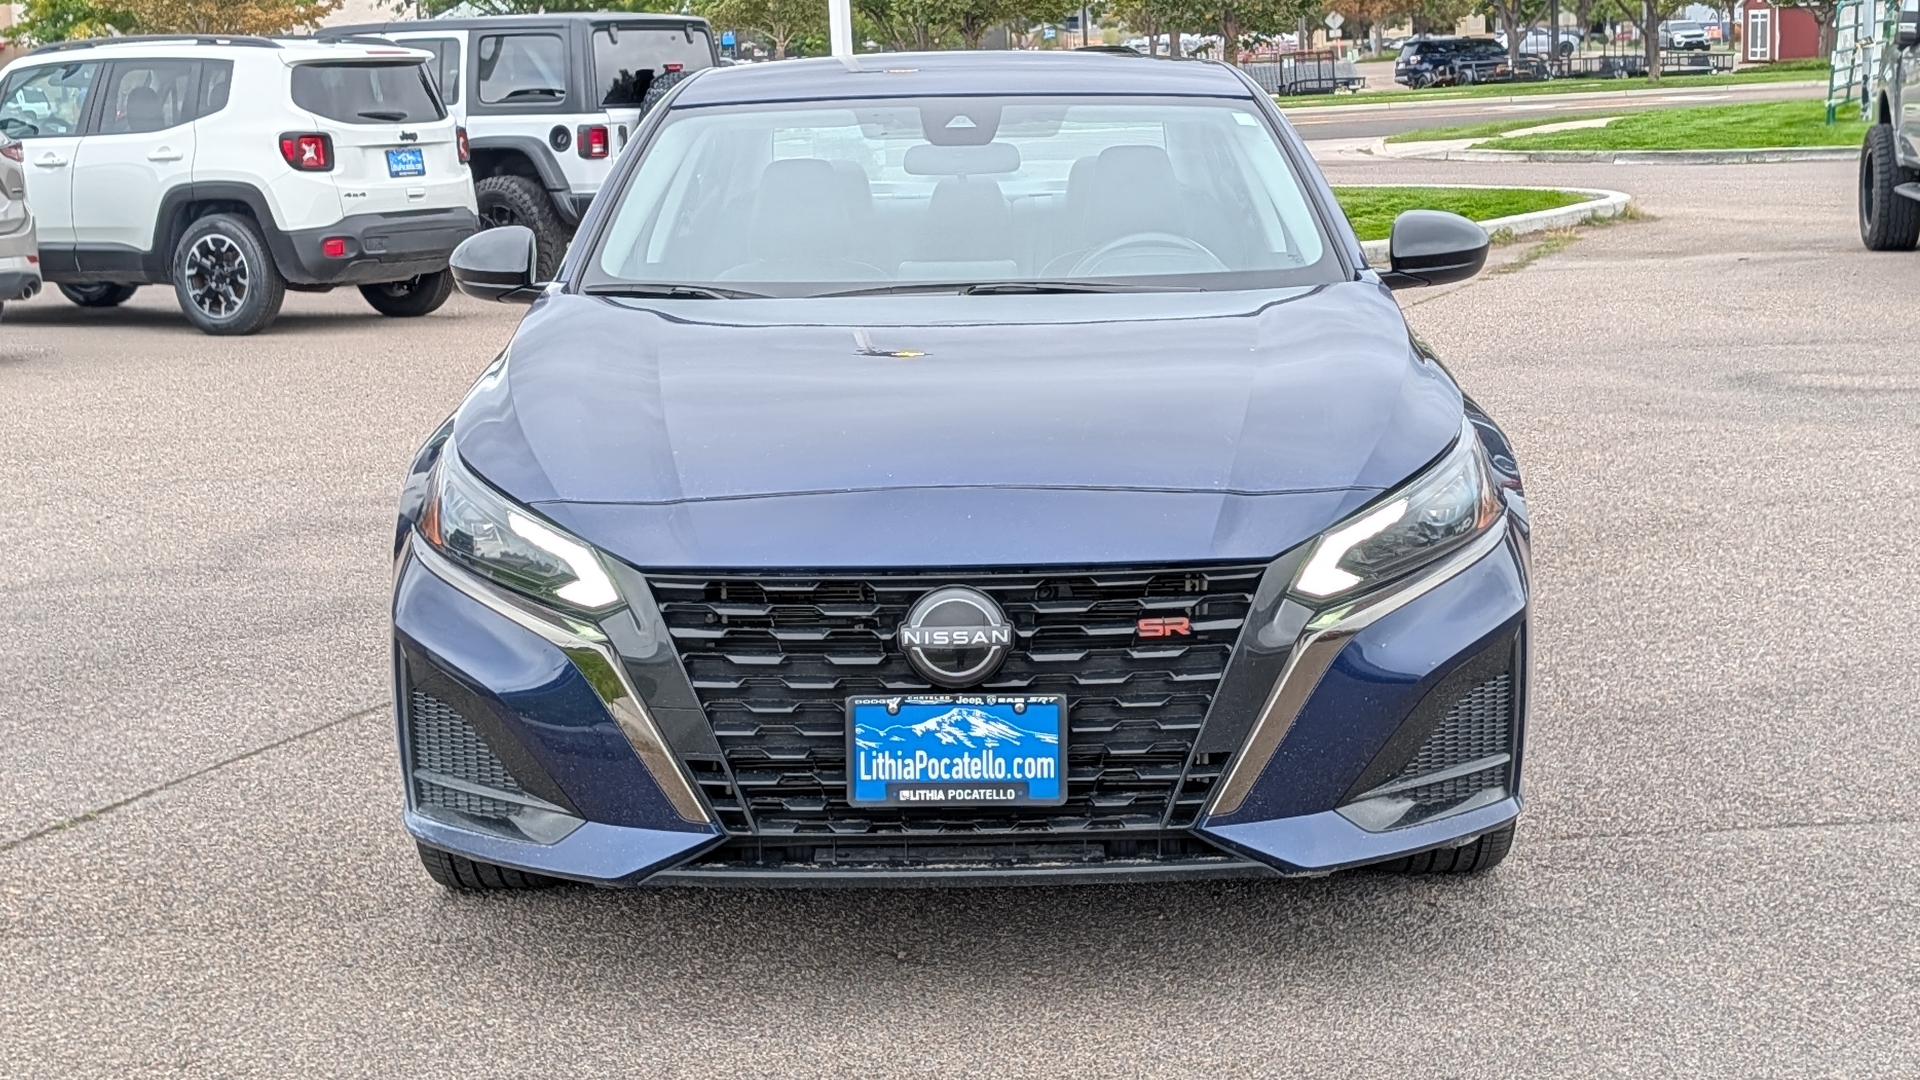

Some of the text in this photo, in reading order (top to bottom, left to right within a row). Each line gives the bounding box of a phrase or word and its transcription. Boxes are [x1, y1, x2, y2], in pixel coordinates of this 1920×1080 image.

[399, 131, 418, 142] Jeep
[1138, 617, 1190, 637] SR
[903, 629, 1009, 645] NISSAN
[955, 695, 983, 705] Jeep
[859, 749, 1055, 781] LithiaPocatello.com
[910, 789, 1016, 801] LITHIA POCATELLO
